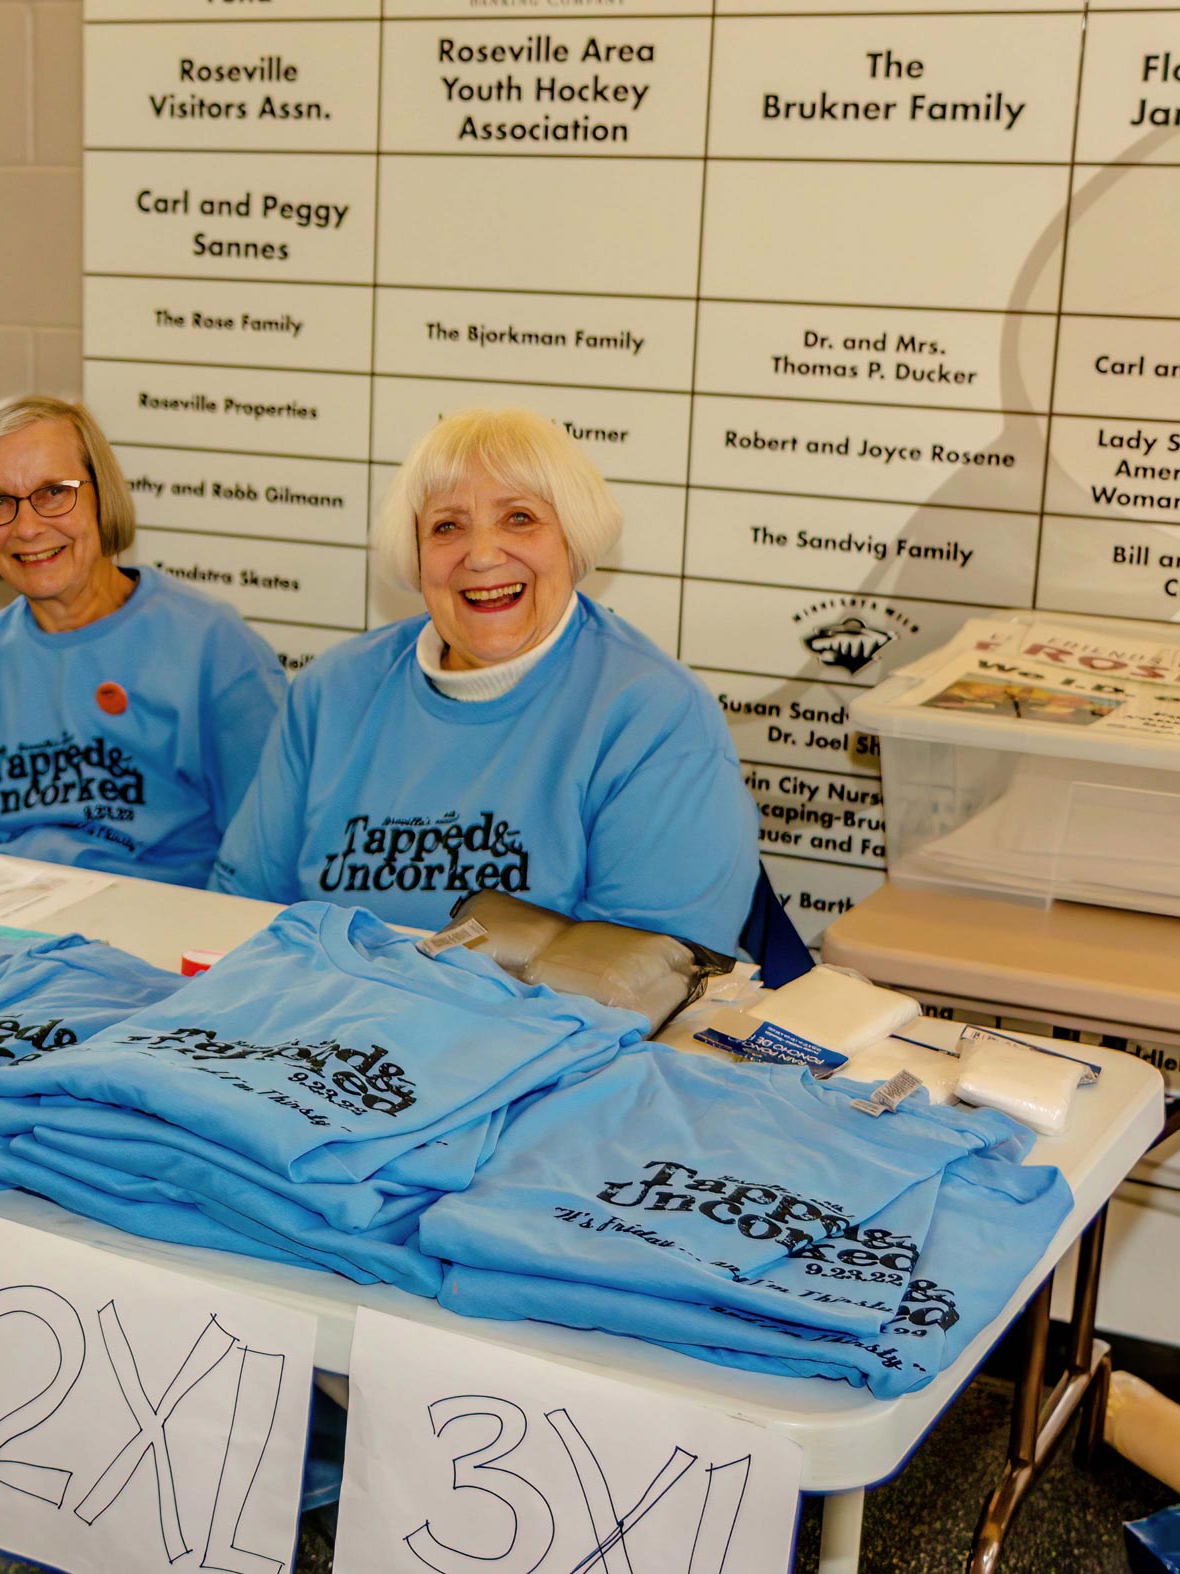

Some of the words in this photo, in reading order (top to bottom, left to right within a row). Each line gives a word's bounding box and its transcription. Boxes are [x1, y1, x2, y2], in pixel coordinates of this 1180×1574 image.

[438, 35, 568, 64] Roseville
[581, 38, 656, 63] Area
[179, 56, 298, 83] Roseville
[866, 50, 924, 80] The
[442, 75, 521, 102] Youth
[535, 76, 650, 111] Hockey
[149, 95, 248, 120] Visitors
[258, 96, 331, 120] Assn.
[763, 92, 897, 121] Brukner
[909, 92, 1026, 131] Family
[458, 116, 629, 143] Association
[137, 189, 188, 215] Carl
[200, 193, 250, 217] and
[263, 195, 350, 230] Peggy
[192, 233, 290, 261] Sannes
[154, 309, 185, 329] The
[191, 312, 234, 331] Rose
[241, 314, 304, 337] Family
[426, 322, 460, 342] The
[467, 325, 567, 348] Bjorkman
[575, 330, 645, 355] Family
[803, 330, 834, 350] Dr.
[843, 333, 886, 354] and
[894, 334, 947, 356] Mrs.
[771, 355, 859, 379] Thomas
[867, 361, 886, 380] P.
[895, 363, 978, 386] Ducker
[1094, 355, 1144, 376] Carl
[138, 392, 218, 414] Roseville
[224, 398, 318, 422] Properties
[563, 420, 629, 443] Turner
[1098, 428, 1158, 456] Lady
[724, 430, 799, 453] Robert
[806, 434, 850, 457] and
[857, 439, 922, 464] Joyce
[931, 444, 1016, 469] Rosene
[127, 476, 164, 498] athy
[171, 480, 207, 498] and
[211, 483, 258, 501] Robb
[265, 486, 345, 508] Gilmann
[751, 526, 788, 547] The
[796, 530, 888, 560] Sandvig
[895, 539, 974, 569] Family
[1113, 545, 1149, 566] Bill
[239, 568, 300, 592] Skates
[1024, 642, 1180, 682] ROS
[718, 693, 781, 718] Susan
[789, 701, 849, 725] Sand
[768, 725, 796, 746] Dr.
[805, 730, 849, 751] Joel
[778, 776, 819, 802] City
[810, 835, 852, 853] and
[319, 849, 531, 892] Uncorked
